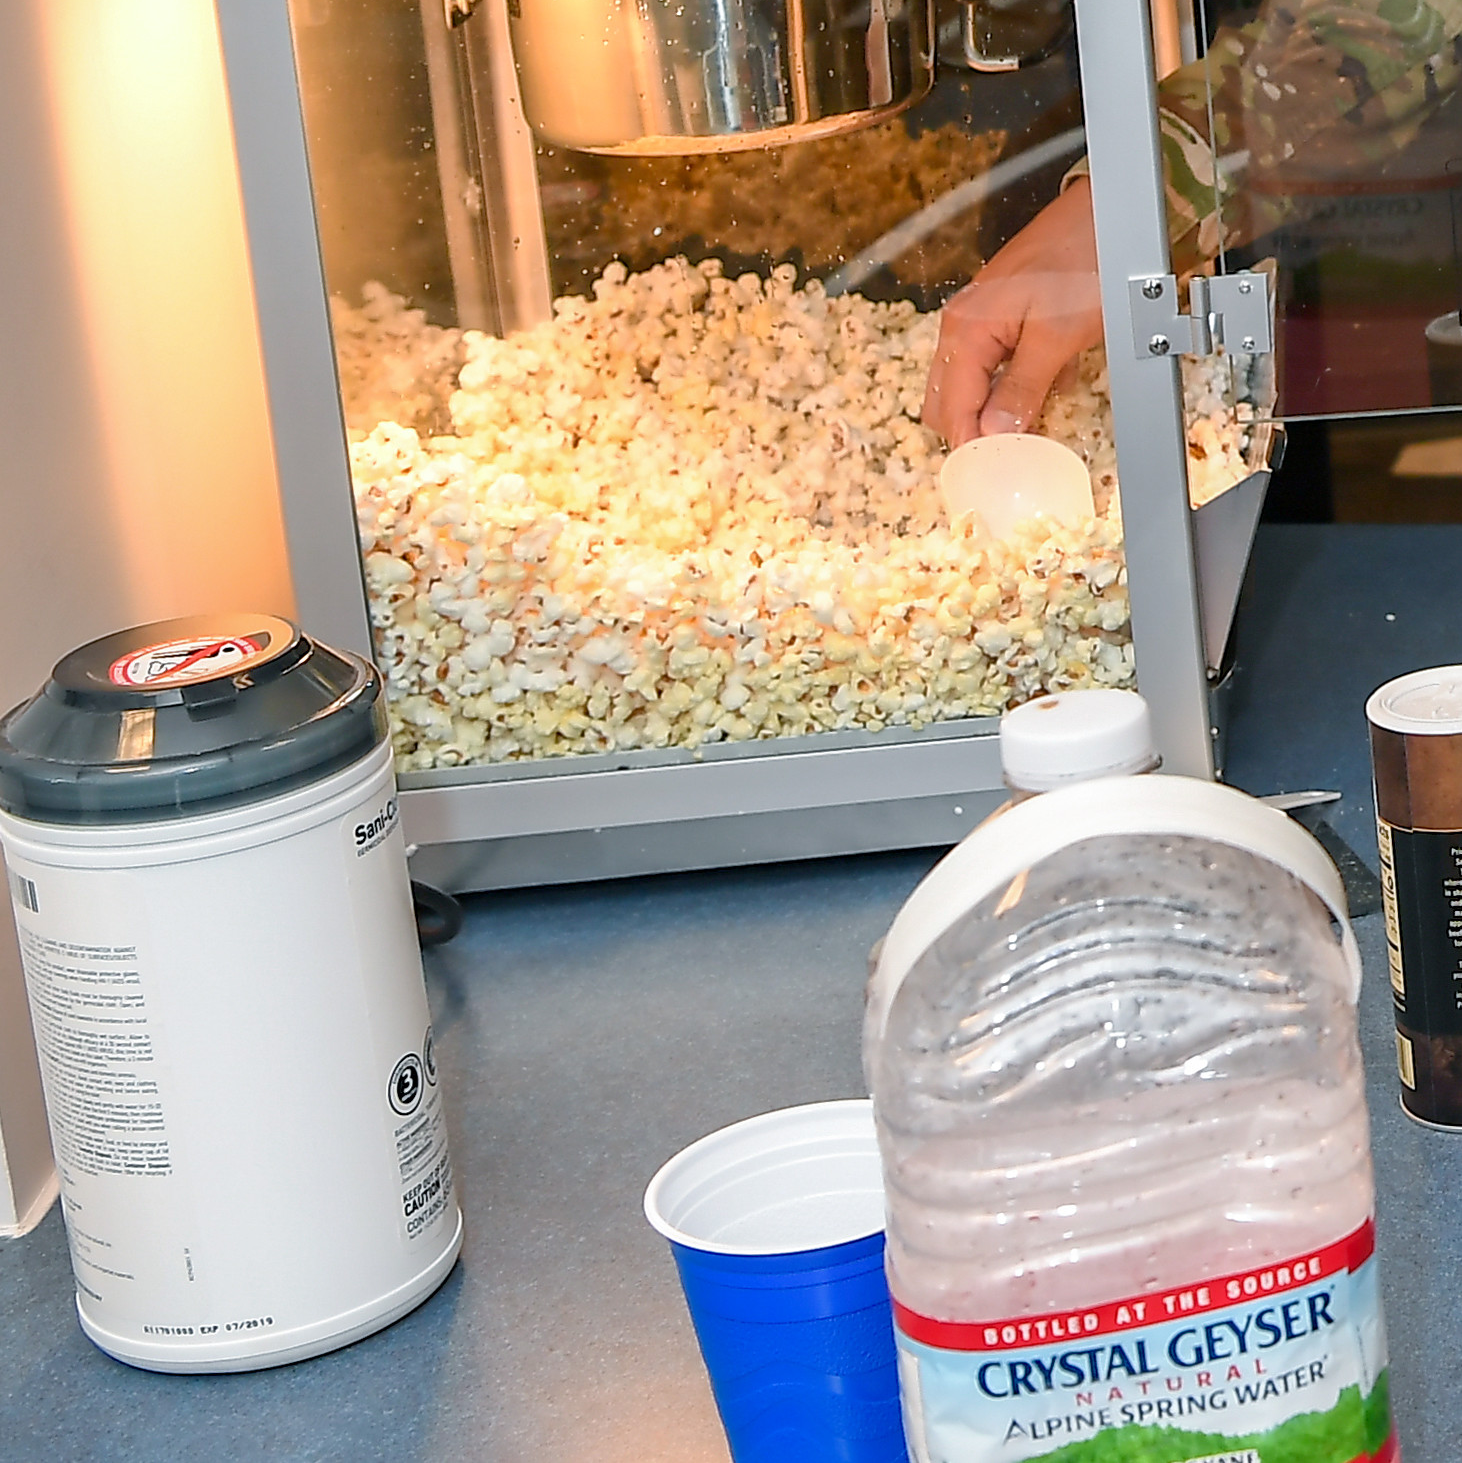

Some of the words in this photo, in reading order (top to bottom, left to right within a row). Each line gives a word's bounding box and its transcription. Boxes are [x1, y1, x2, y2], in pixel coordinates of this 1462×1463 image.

[405, 1179, 440, 1216] CAUTION
[200, 1325, 218, 1334] EXP
[225, 1317, 273, 1331] 07/2019
[983, 1315, 1098, 1346] BOTTLED
[1116, 1302, 1147, 1324] AT
[1163, 1289, 1211, 1315] THE
[1226, 1257, 1322, 1299] SOURCE
[976, 1344, 1159, 1400] CRYSTAL
[1167, 1292, 1334, 1367] GEYSER
[1002, 1407, 1112, 1446] ALPINE
[1120, 1391, 1228, 1427] SPRING
[1237, 1361, 1326, 1405] WATER
[1075, 1358, 1269, 1406] NATURAL
